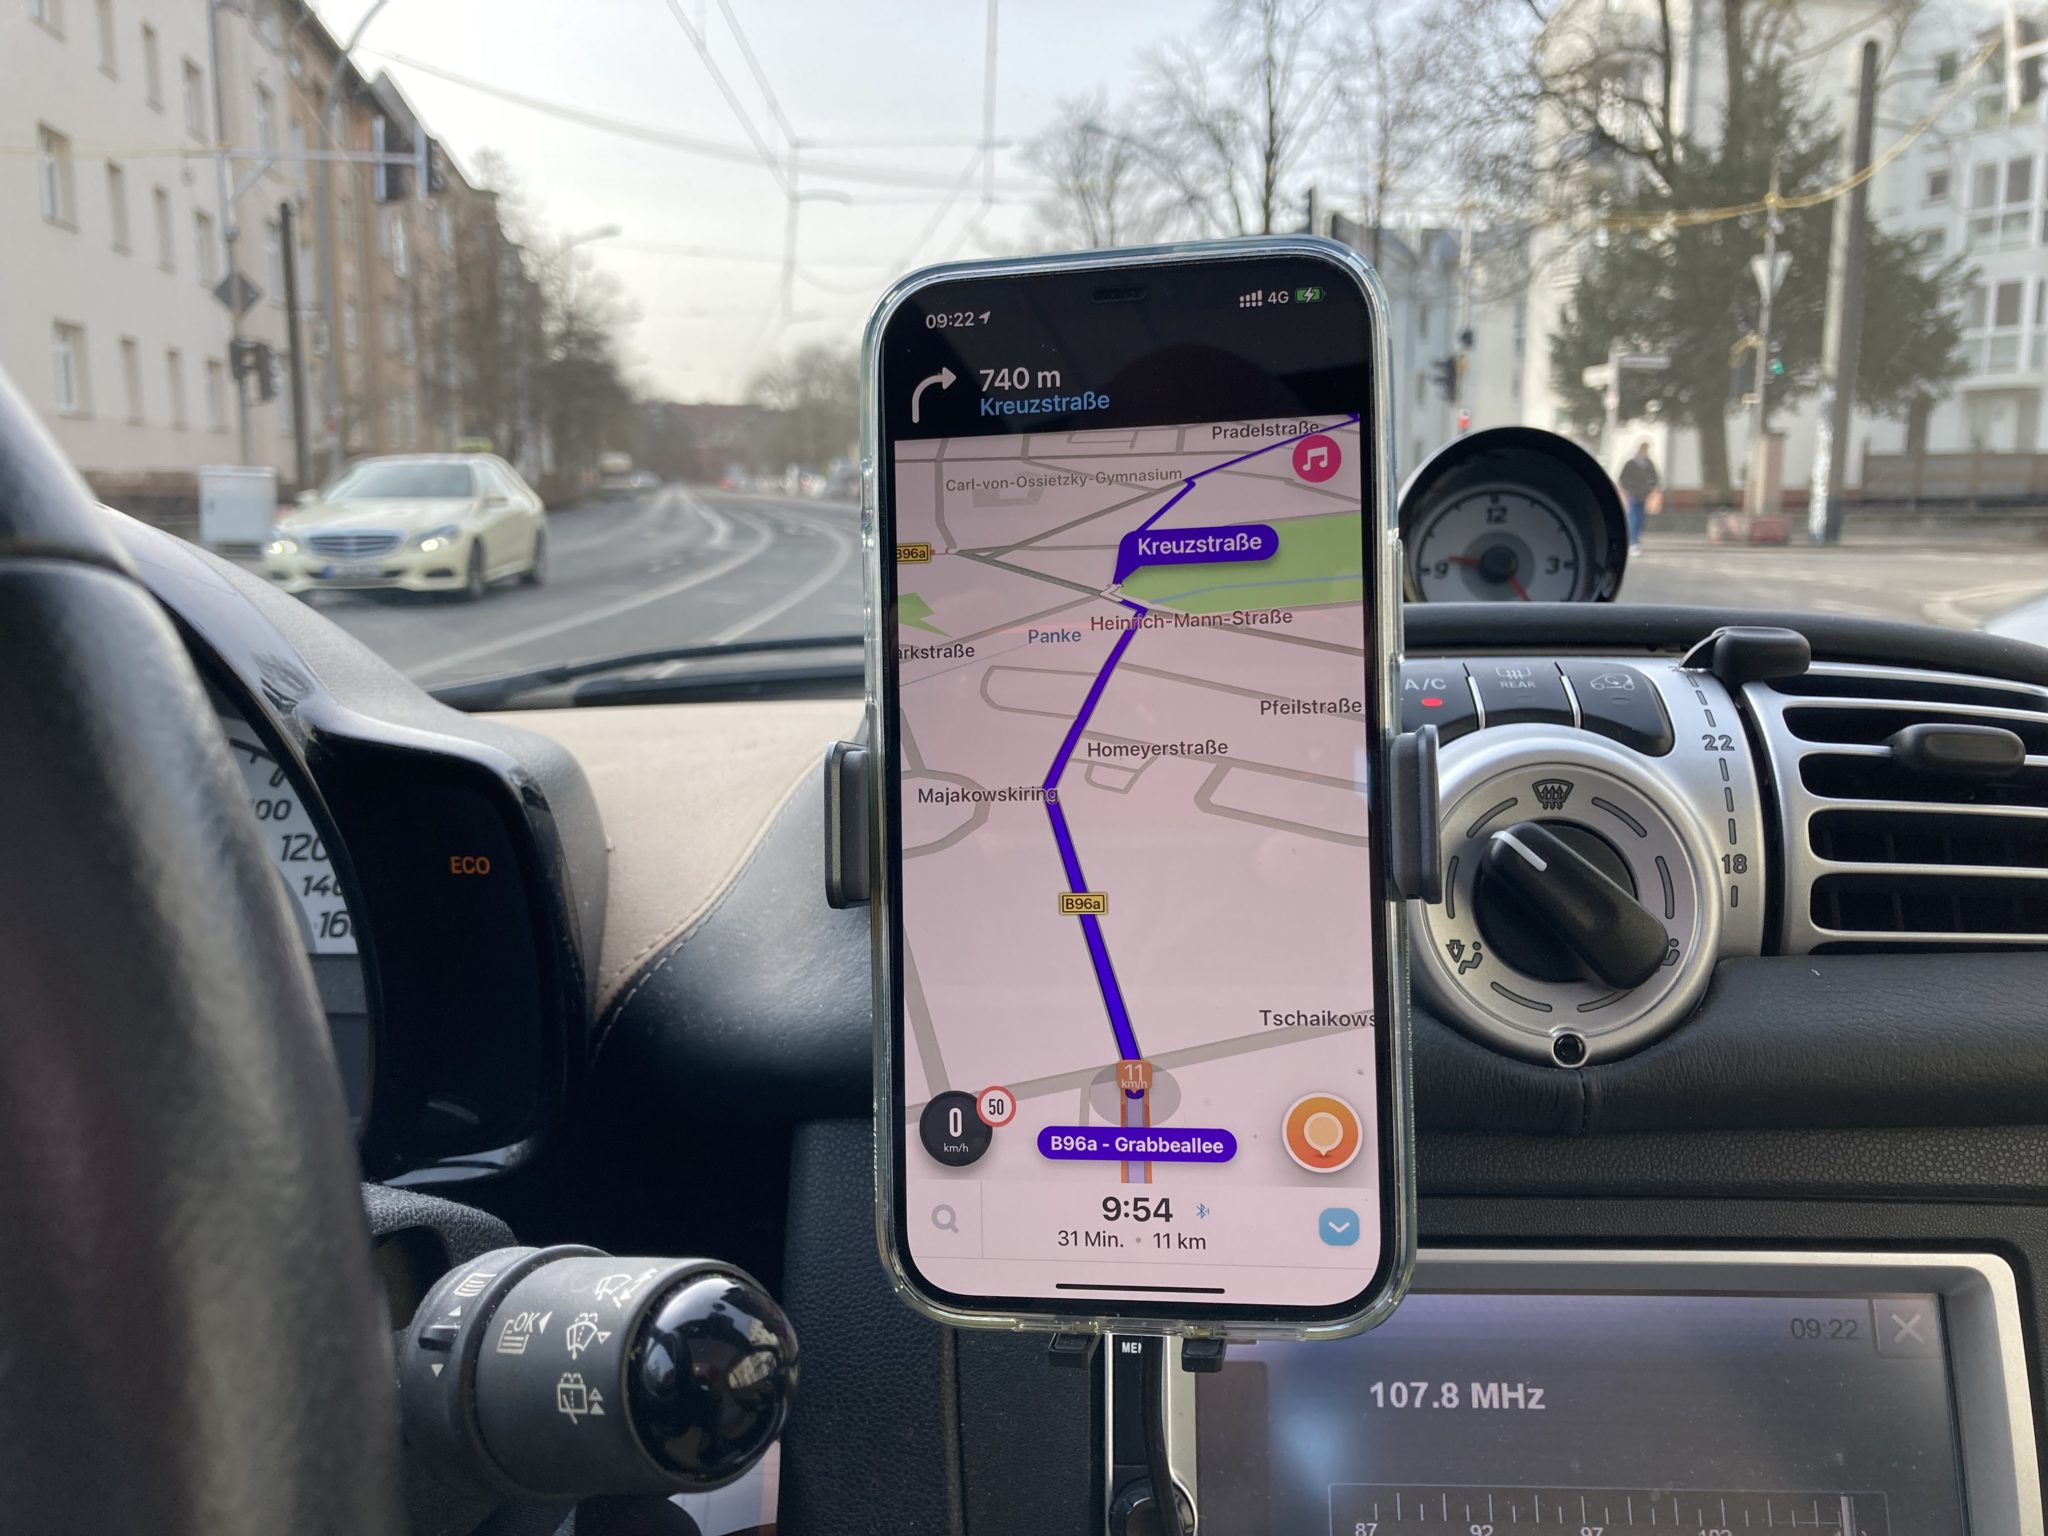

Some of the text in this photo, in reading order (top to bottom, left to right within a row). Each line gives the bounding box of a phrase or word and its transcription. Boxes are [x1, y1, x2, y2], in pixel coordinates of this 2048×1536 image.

[1267, 290, 1290, 304] 4G
[925, 311, 974, 329] 09:22
[980, 366, 1062, 393] 740 m
[980, 391, 1110, 417] Kreuzstraße
[1212, 420, 1320, 440] Pradelstraße
[945, 467, 1183, 492] Carl-von-Ossietzky-Gymnasium
[1486, 506, 1508, 524] 12
[1137, 533, 1262, 557] Kreuzstraße
[1434, 560, 1449, 579] 9
[1545, 556, 1560, 575] 3
[1090, 609, 1293, 632] Heinrich-Mann-Straße
[1027, 628, 1082, 645] Panke
[1404, 678, 1447, 691] A/C
[1500, 680, 1536, 689] REAR
[1260, 697, 1363, 716] Pfeilstraße
[1086, 739, 1229, 760] Homeyerstraße
[1701, 735, 1736, 752] 22
[917, 785, 1059, 804] Majakowskiring
[450, 856, 491, 875] ECO
[1722, 854, 1748, 874] 18
[1065, 897, 1101, 910] B96a
[1124, 1064, 1143, 1080] 11
[1121, 1078, 1148, 1089] km/h
[988, 1098, 1004, 1116] 50
[949, 1107, 963, 1138] 0
[943, 1142, 969, 1153] km/h
[1049, 1134, 1098, 1152] B96a
[1114, 1136, 1225, 1155] Grabbeallee
[1101, 1196, 1174, 1223] 9:54
[1057, 1230, 1207, 1250] 31 Min. 11 km
[513, 1311, 541, 1334] OK
[1789, 1317, 1860, 1341] 09:22
[1368, 1381, 1547, 1412] 107.8 MHz
